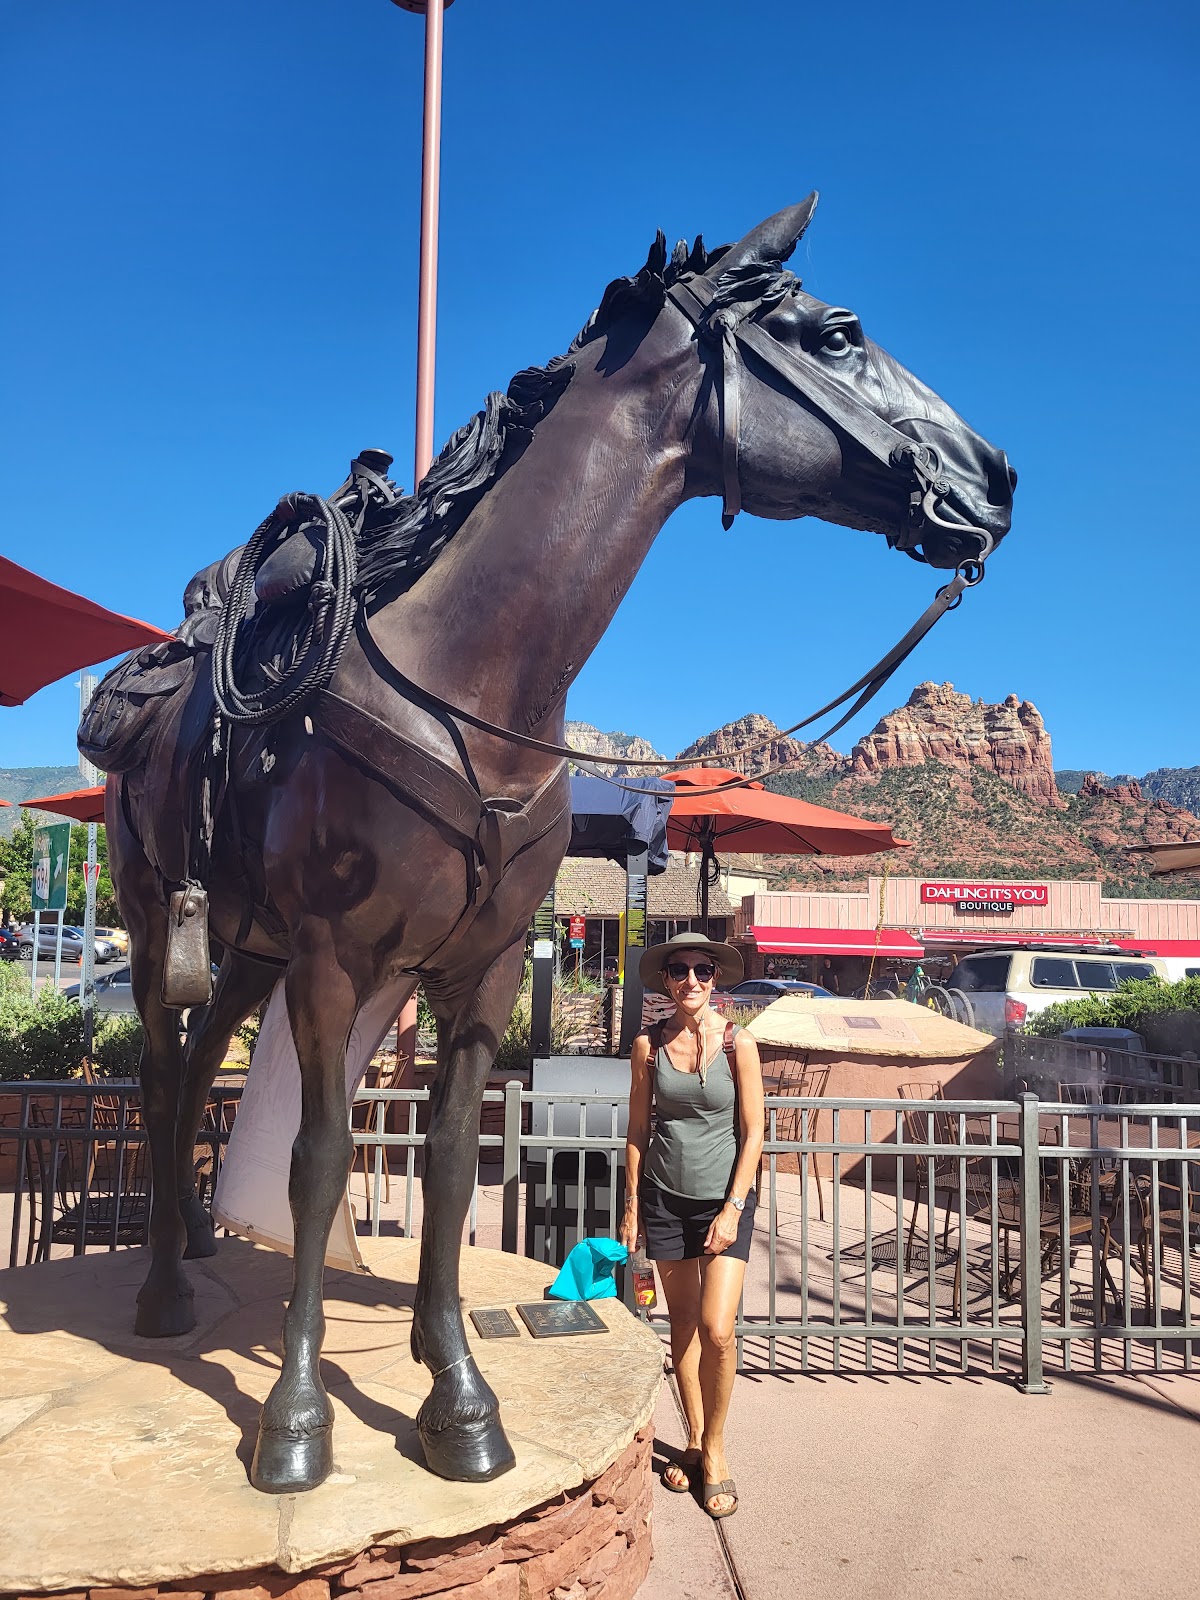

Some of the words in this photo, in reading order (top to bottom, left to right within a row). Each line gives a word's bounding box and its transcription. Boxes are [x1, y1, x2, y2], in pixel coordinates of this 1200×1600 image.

[926, 887, 988, 899] DAHLING
[990, 888, 1012, 900] IT'S
[1013, 889, 1045, 900] YOU
[960, 902, 1013, 911] BOUTIQUE
